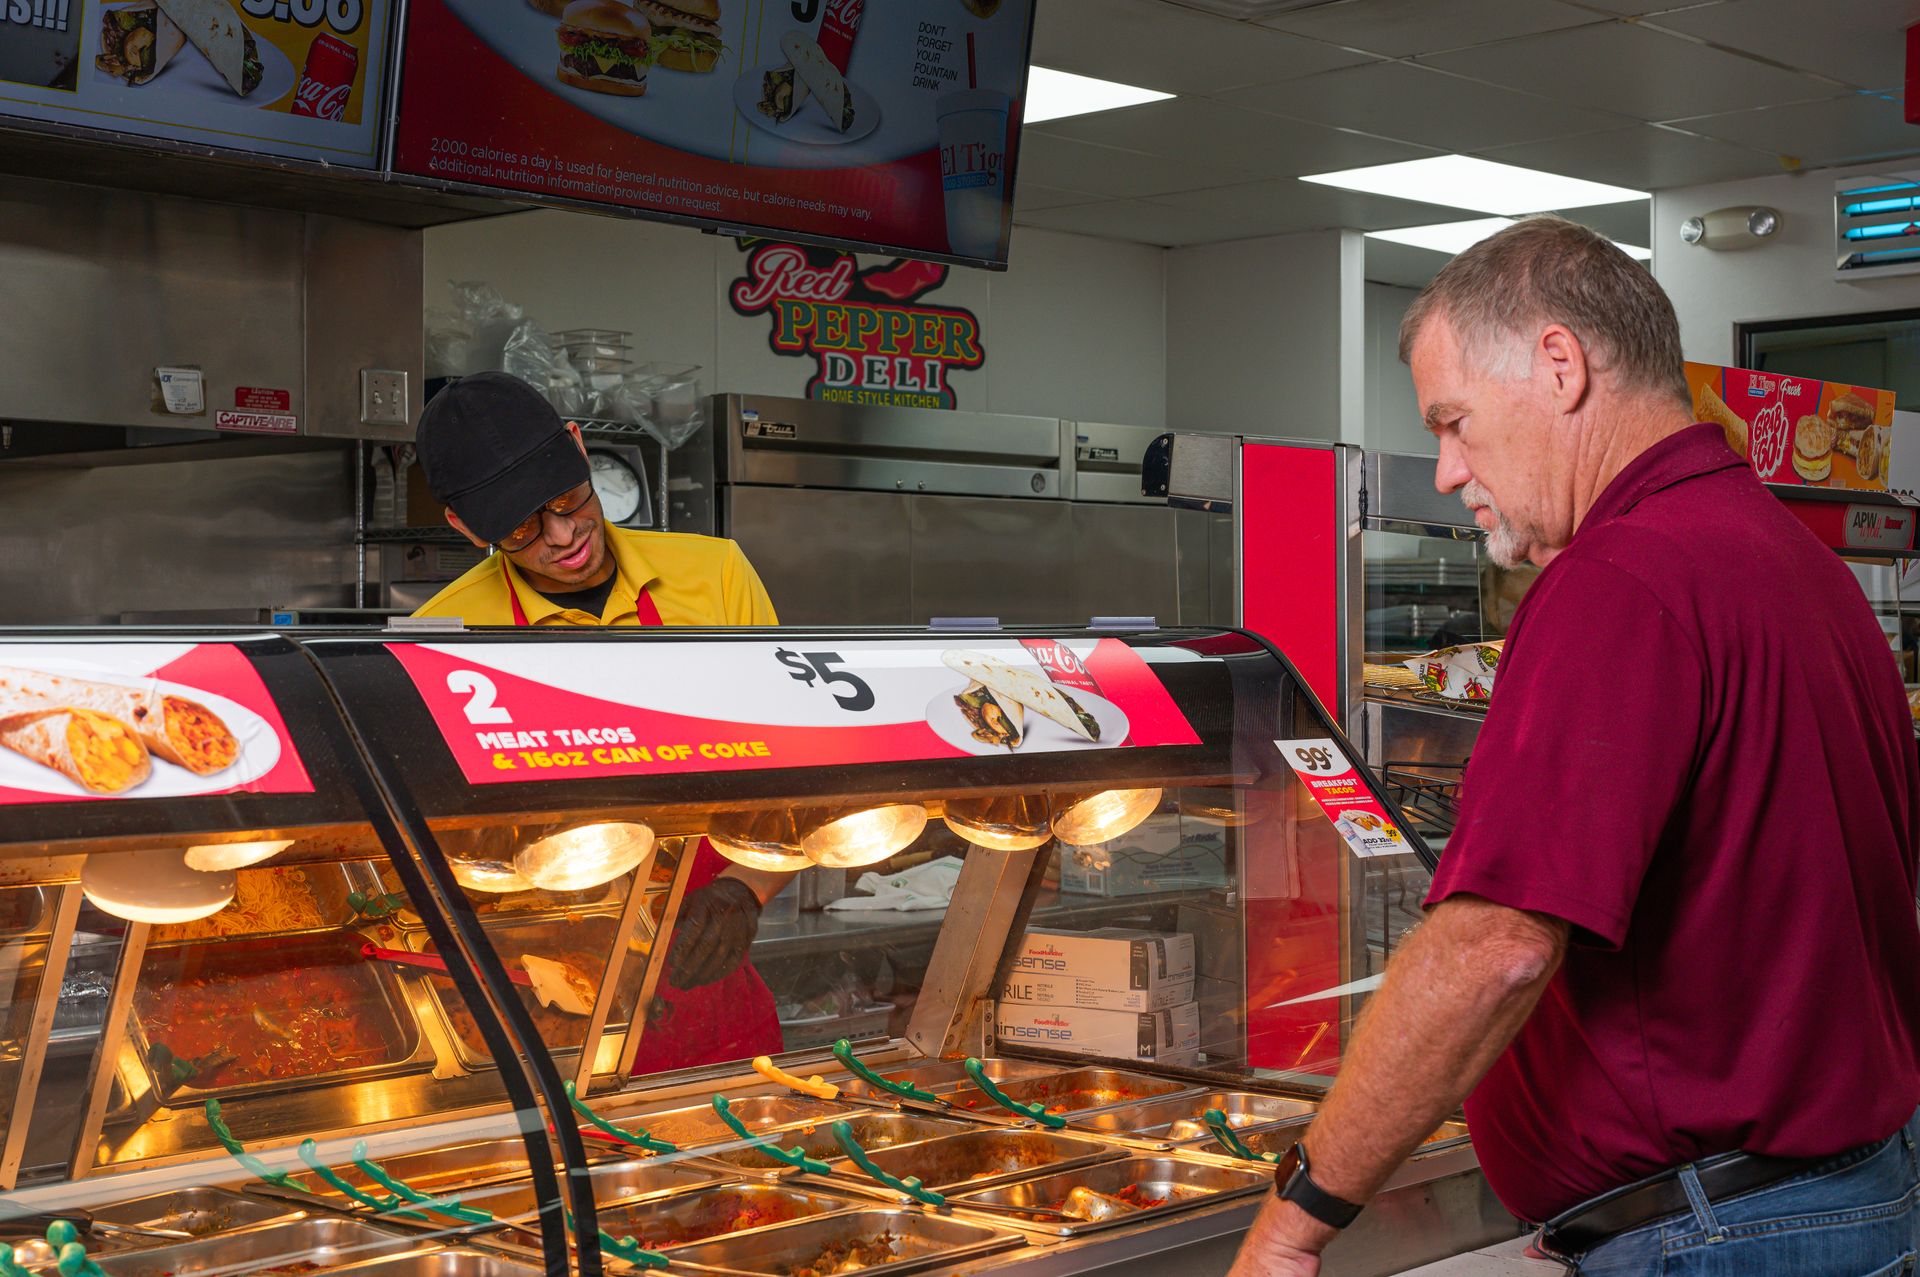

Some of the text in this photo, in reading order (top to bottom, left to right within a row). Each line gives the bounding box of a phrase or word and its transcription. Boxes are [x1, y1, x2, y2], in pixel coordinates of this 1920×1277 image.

[917, 35, 952, 52] FORGET
[917, 48, 941, 64] YOUR
[914, 62, 958, 80] FOUNTAIN
[912, 76, 940, 91] DRINK
[941, 144, 957, 176] El
[430, 137, 873, 222] 2,000 calories a day is used for general nutrition advice, but calorie needs may vary.
[430, 155, 722, 214] Additional nutrition information provided on request.
[737, 247, 854, 307] Red
[775, 298, 979, 361] PEPPER
[824, 351, 943, 392] DELI
[822, 389, 941, 408] HOME STYLE KITCHEN
[1754, 403, 1782, 442] GRAB
[1853, 511, 1878, 529] APW
[774, 647, 876, 713] $5
[446, 669, 514, 725] 2
[475, 727, 637, 750] MEAT TACOS
[491, 752, 517, 770] &
[589, 746, 653, 766] CAN
[656, 744, 693, 762] OF
[698, 740, 772, 760] COKE
[1310, 778, 1358, 789] BREAKFAST
[1324, 787, 1356, 795] TACOS
[1134, 975, 1143, 988] L
[1140, 1043, 1151, 1056] M
